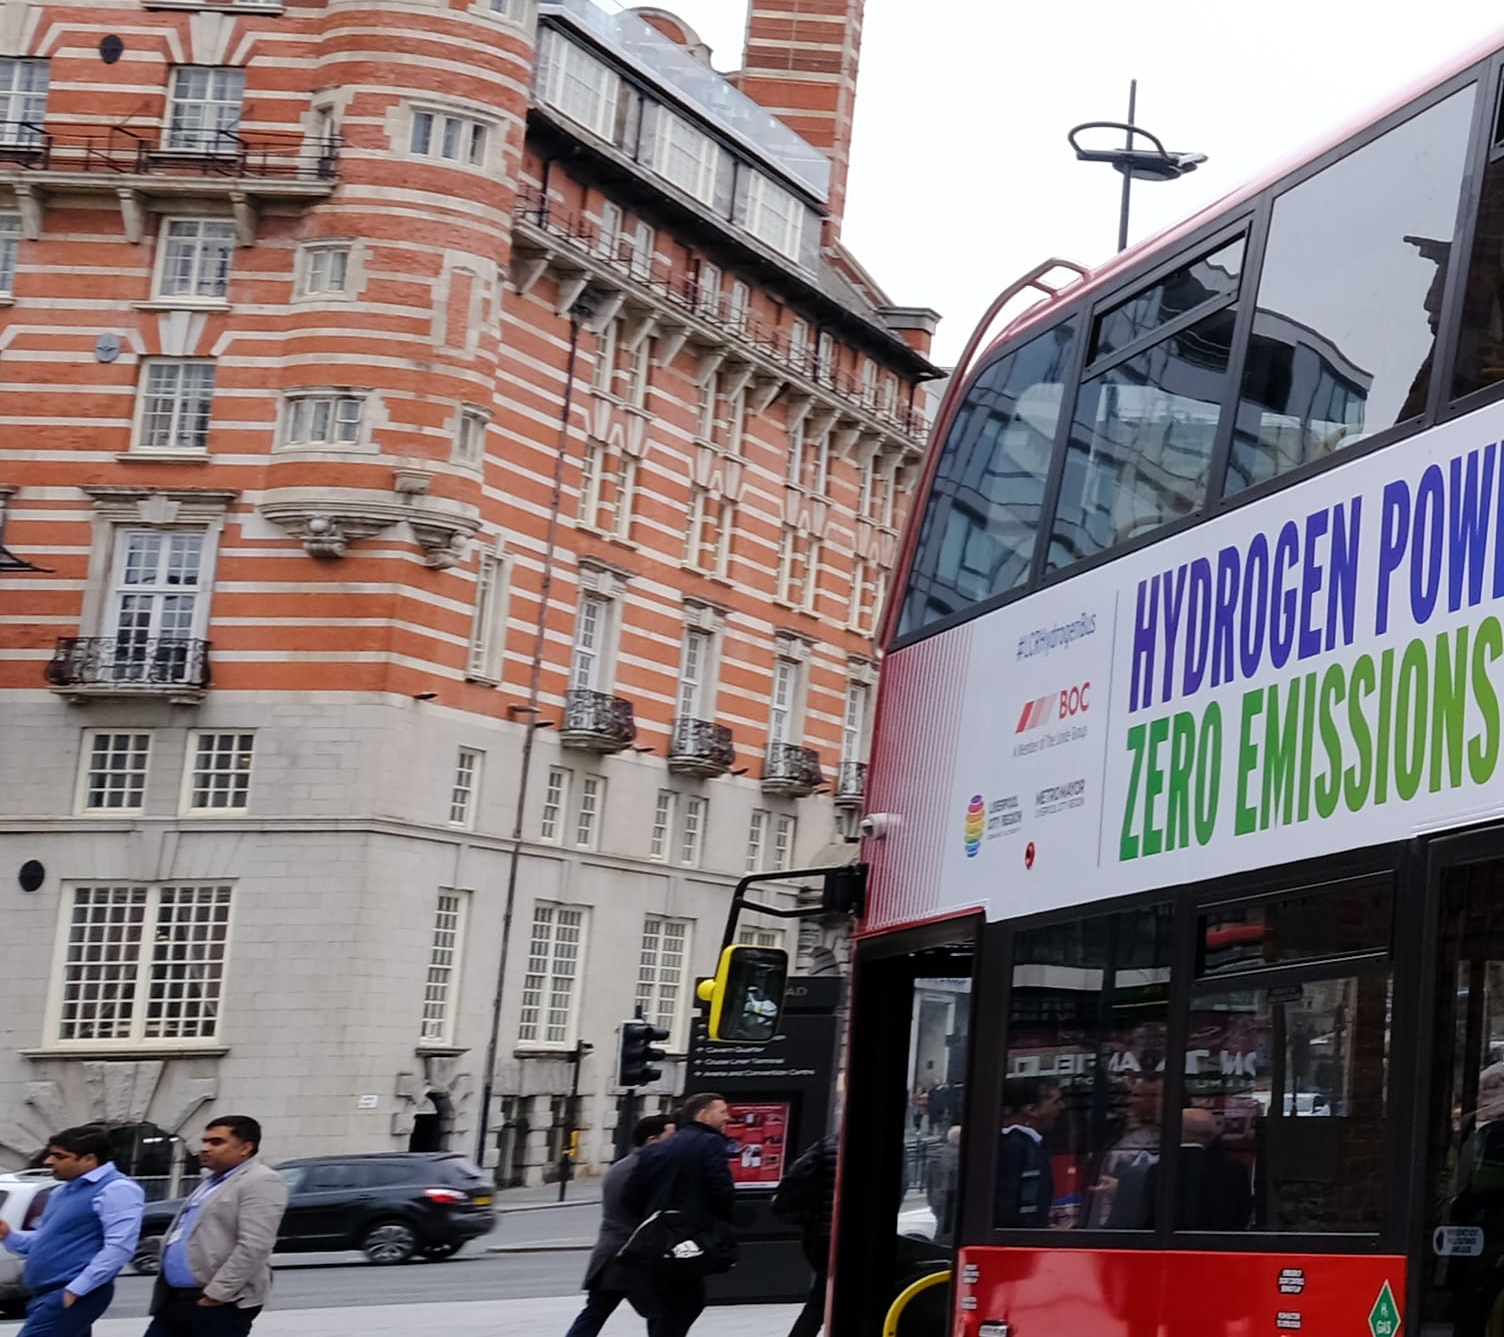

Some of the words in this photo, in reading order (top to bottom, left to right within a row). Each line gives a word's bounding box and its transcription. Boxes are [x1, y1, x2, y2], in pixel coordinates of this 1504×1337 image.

[1128, 496, 1362, 713] HYDROGEN
[1059, 681, 1090, 719] BOC
[1118, 711, 1224, 862] ZERO
